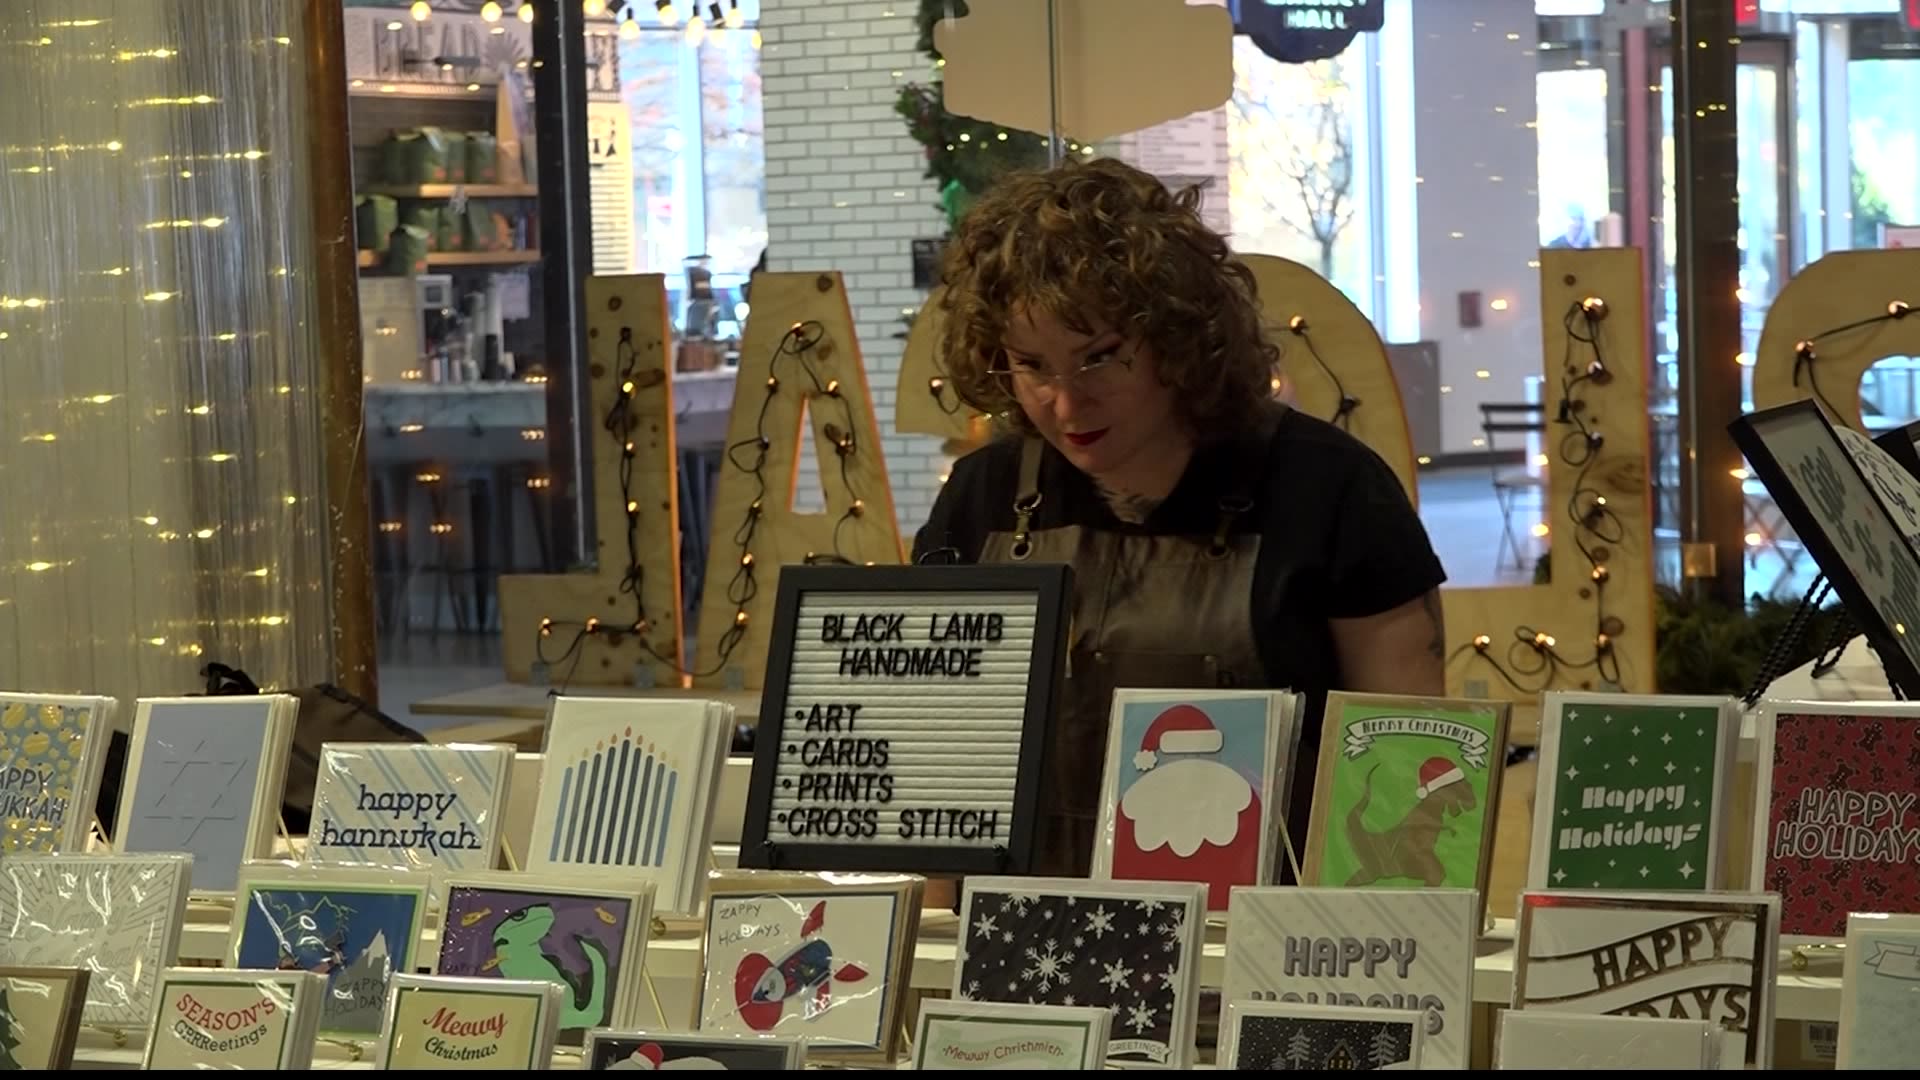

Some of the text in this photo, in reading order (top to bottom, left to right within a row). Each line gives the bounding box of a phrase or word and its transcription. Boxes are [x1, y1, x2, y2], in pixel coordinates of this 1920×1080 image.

[1283, 8, 1348, 30] HALL
[821, 612, 1004, 643] BLACK LAMB
[838, 647, 983, 678] HANDMADE
[804, 703, 862, 733] ART
[1362, 718, 1476, 743] MERRY CHRISTMAS
[801, 737, 890, 768] CARDS
[357, 783, 457, 821] happy
[797, 772, 894, 802] PRINTS
[1581, 784, 1686, 814] Happy
[1799, 786, 1917, 827] HAPPY
[319, 819, 482, 857] hannukah
[787, 806, 999, 840] CROSS STITCH
[1558, 820, 1703, 851] Holidays
[1773, 821, 1920, 864] HOLIDAY
[720, 903, 762, 919] ZAPPY
[1284, 936, 1417, 979] HAPPY
[1593, 917, 1735, 991] HAPPY
[176, 993, 276, 1031] SEASON'S
[425, 1036, 498, 1061] Christmas
[1109, 1040, 1163, 1057] GREETINGS
